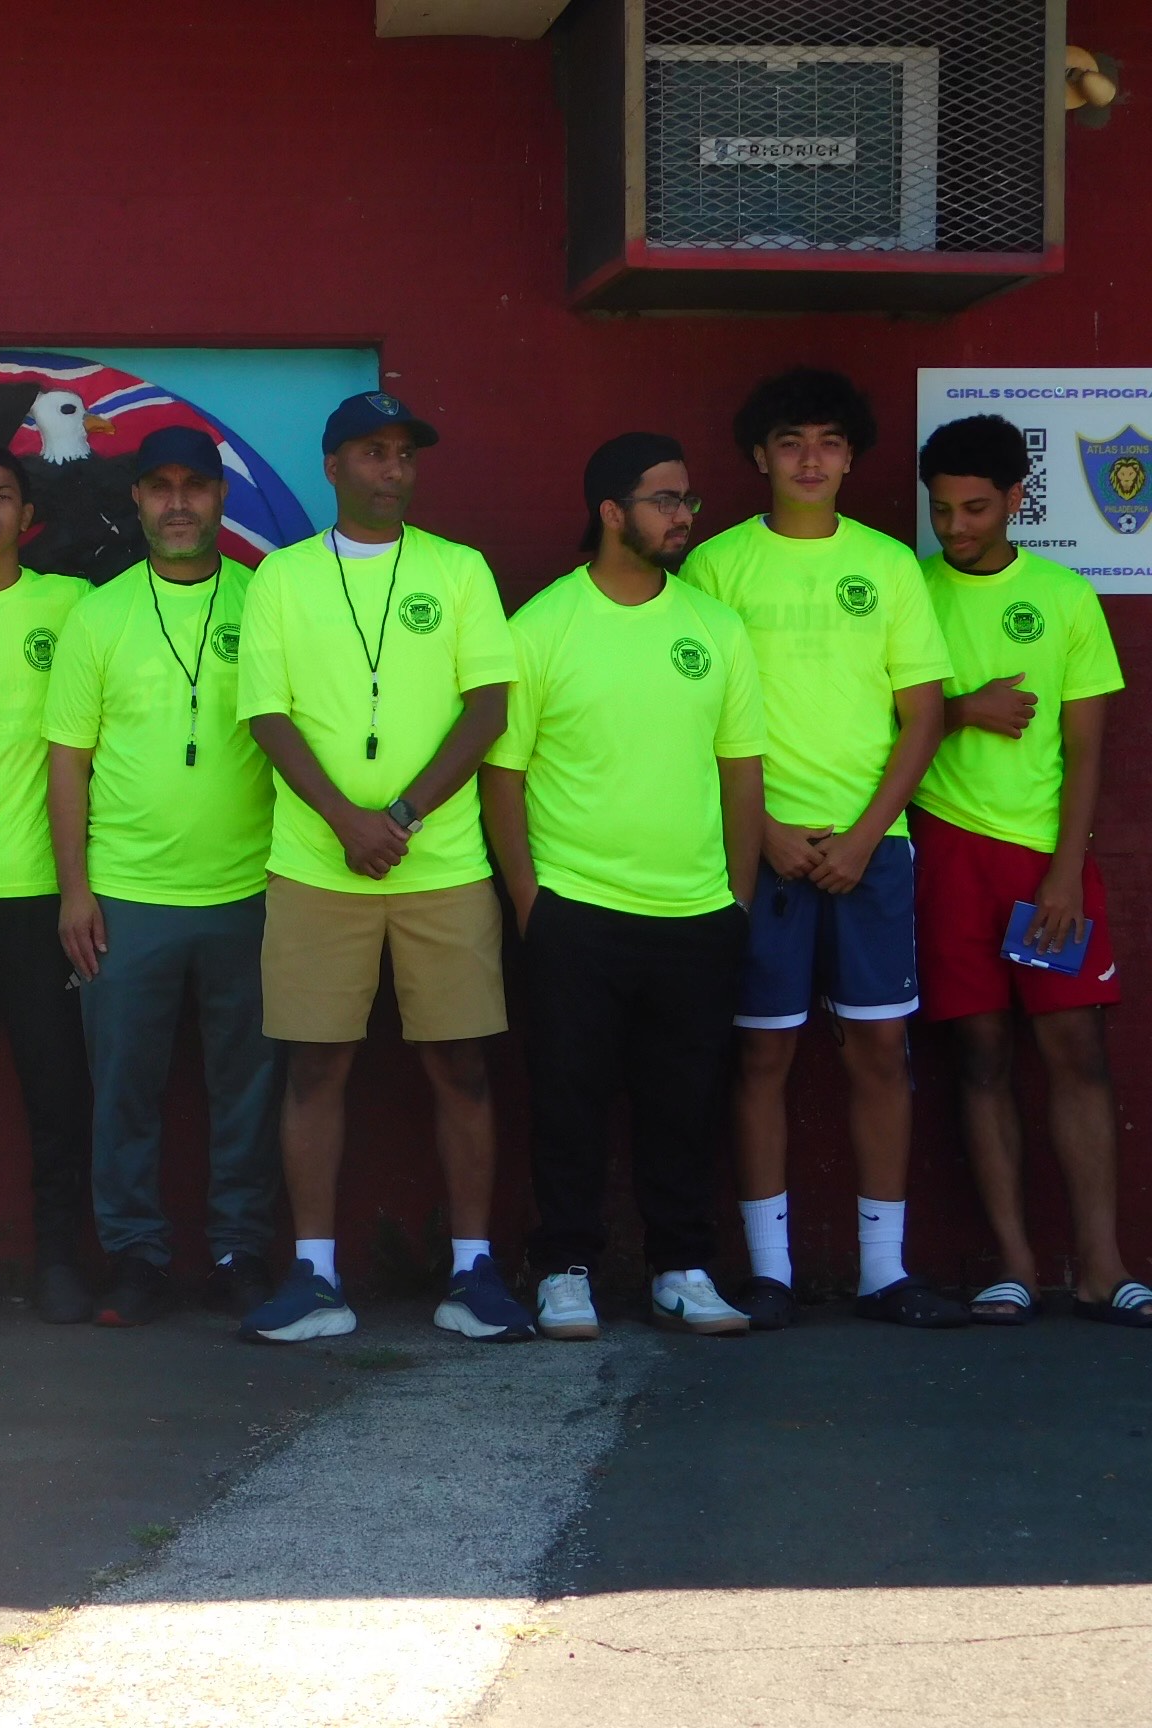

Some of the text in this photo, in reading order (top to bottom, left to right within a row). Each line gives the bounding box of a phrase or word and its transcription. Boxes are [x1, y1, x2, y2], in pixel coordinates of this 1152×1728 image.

[737, 144, 840, 157] FRIEDRICH
[946, 388, 1001, 399] GIRLS
[1087, 445, 1149, 454] ATLAS LIONS
